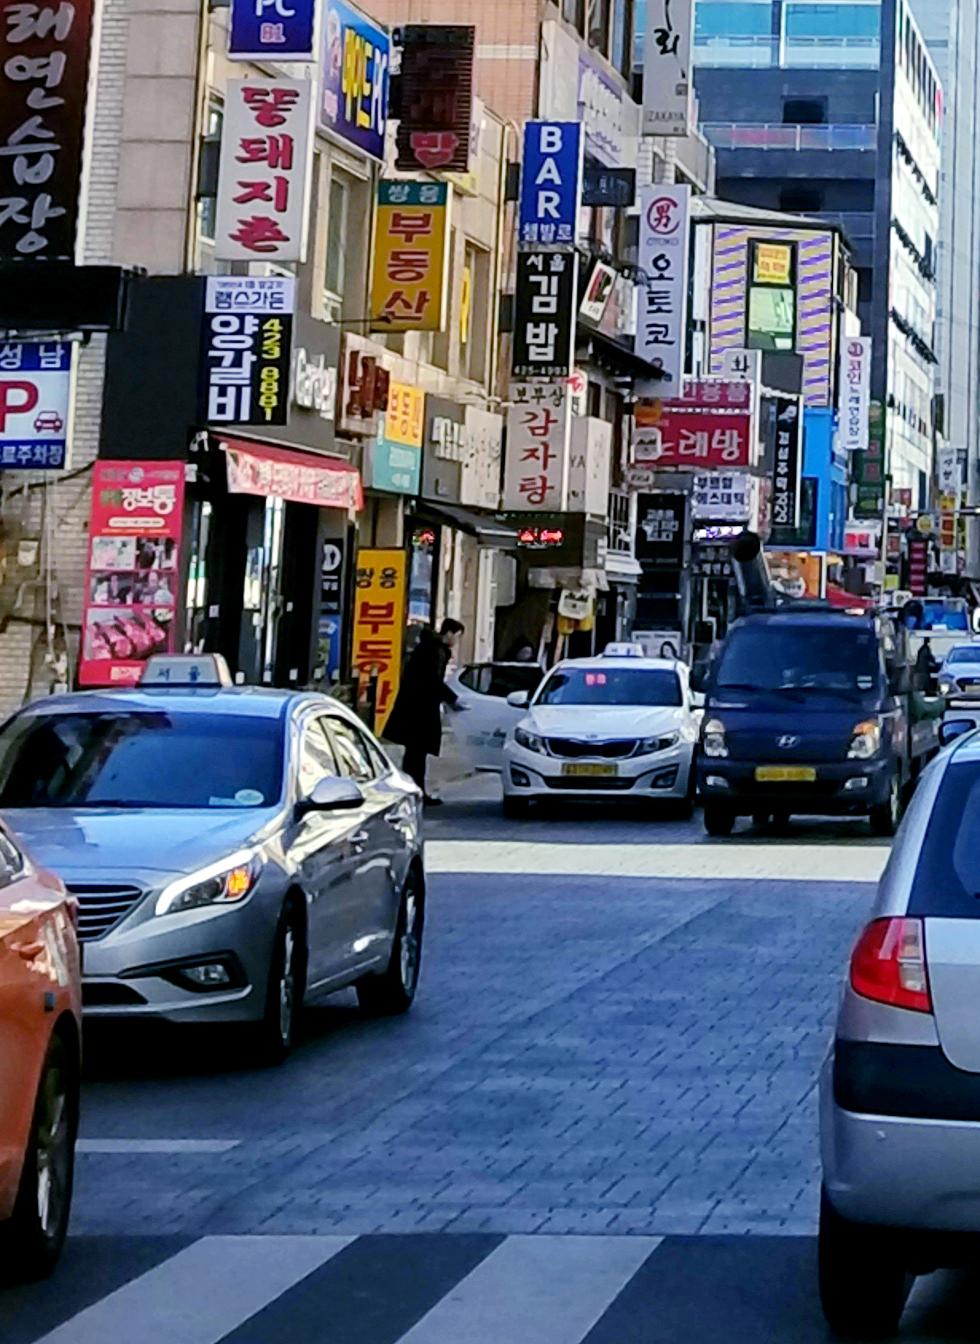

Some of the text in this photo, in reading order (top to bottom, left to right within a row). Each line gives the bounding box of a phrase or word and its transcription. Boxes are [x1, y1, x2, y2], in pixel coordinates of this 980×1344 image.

[535, 125, 563, 219] BAR
[655, 203, 672, 228] 男
[385, 212, 434, 322] 부동산
[526, 254, 566, 272] 서울
[214, 291, 284, 310] 램스가든
[525, 275, 559, 362] 김밥
[208, 315, 259, 421] 양갈비
[513, 385, 564, 407] 보부상
[0, 380, 39, 433] P
[520, 408, 558, 505] 감자탕
